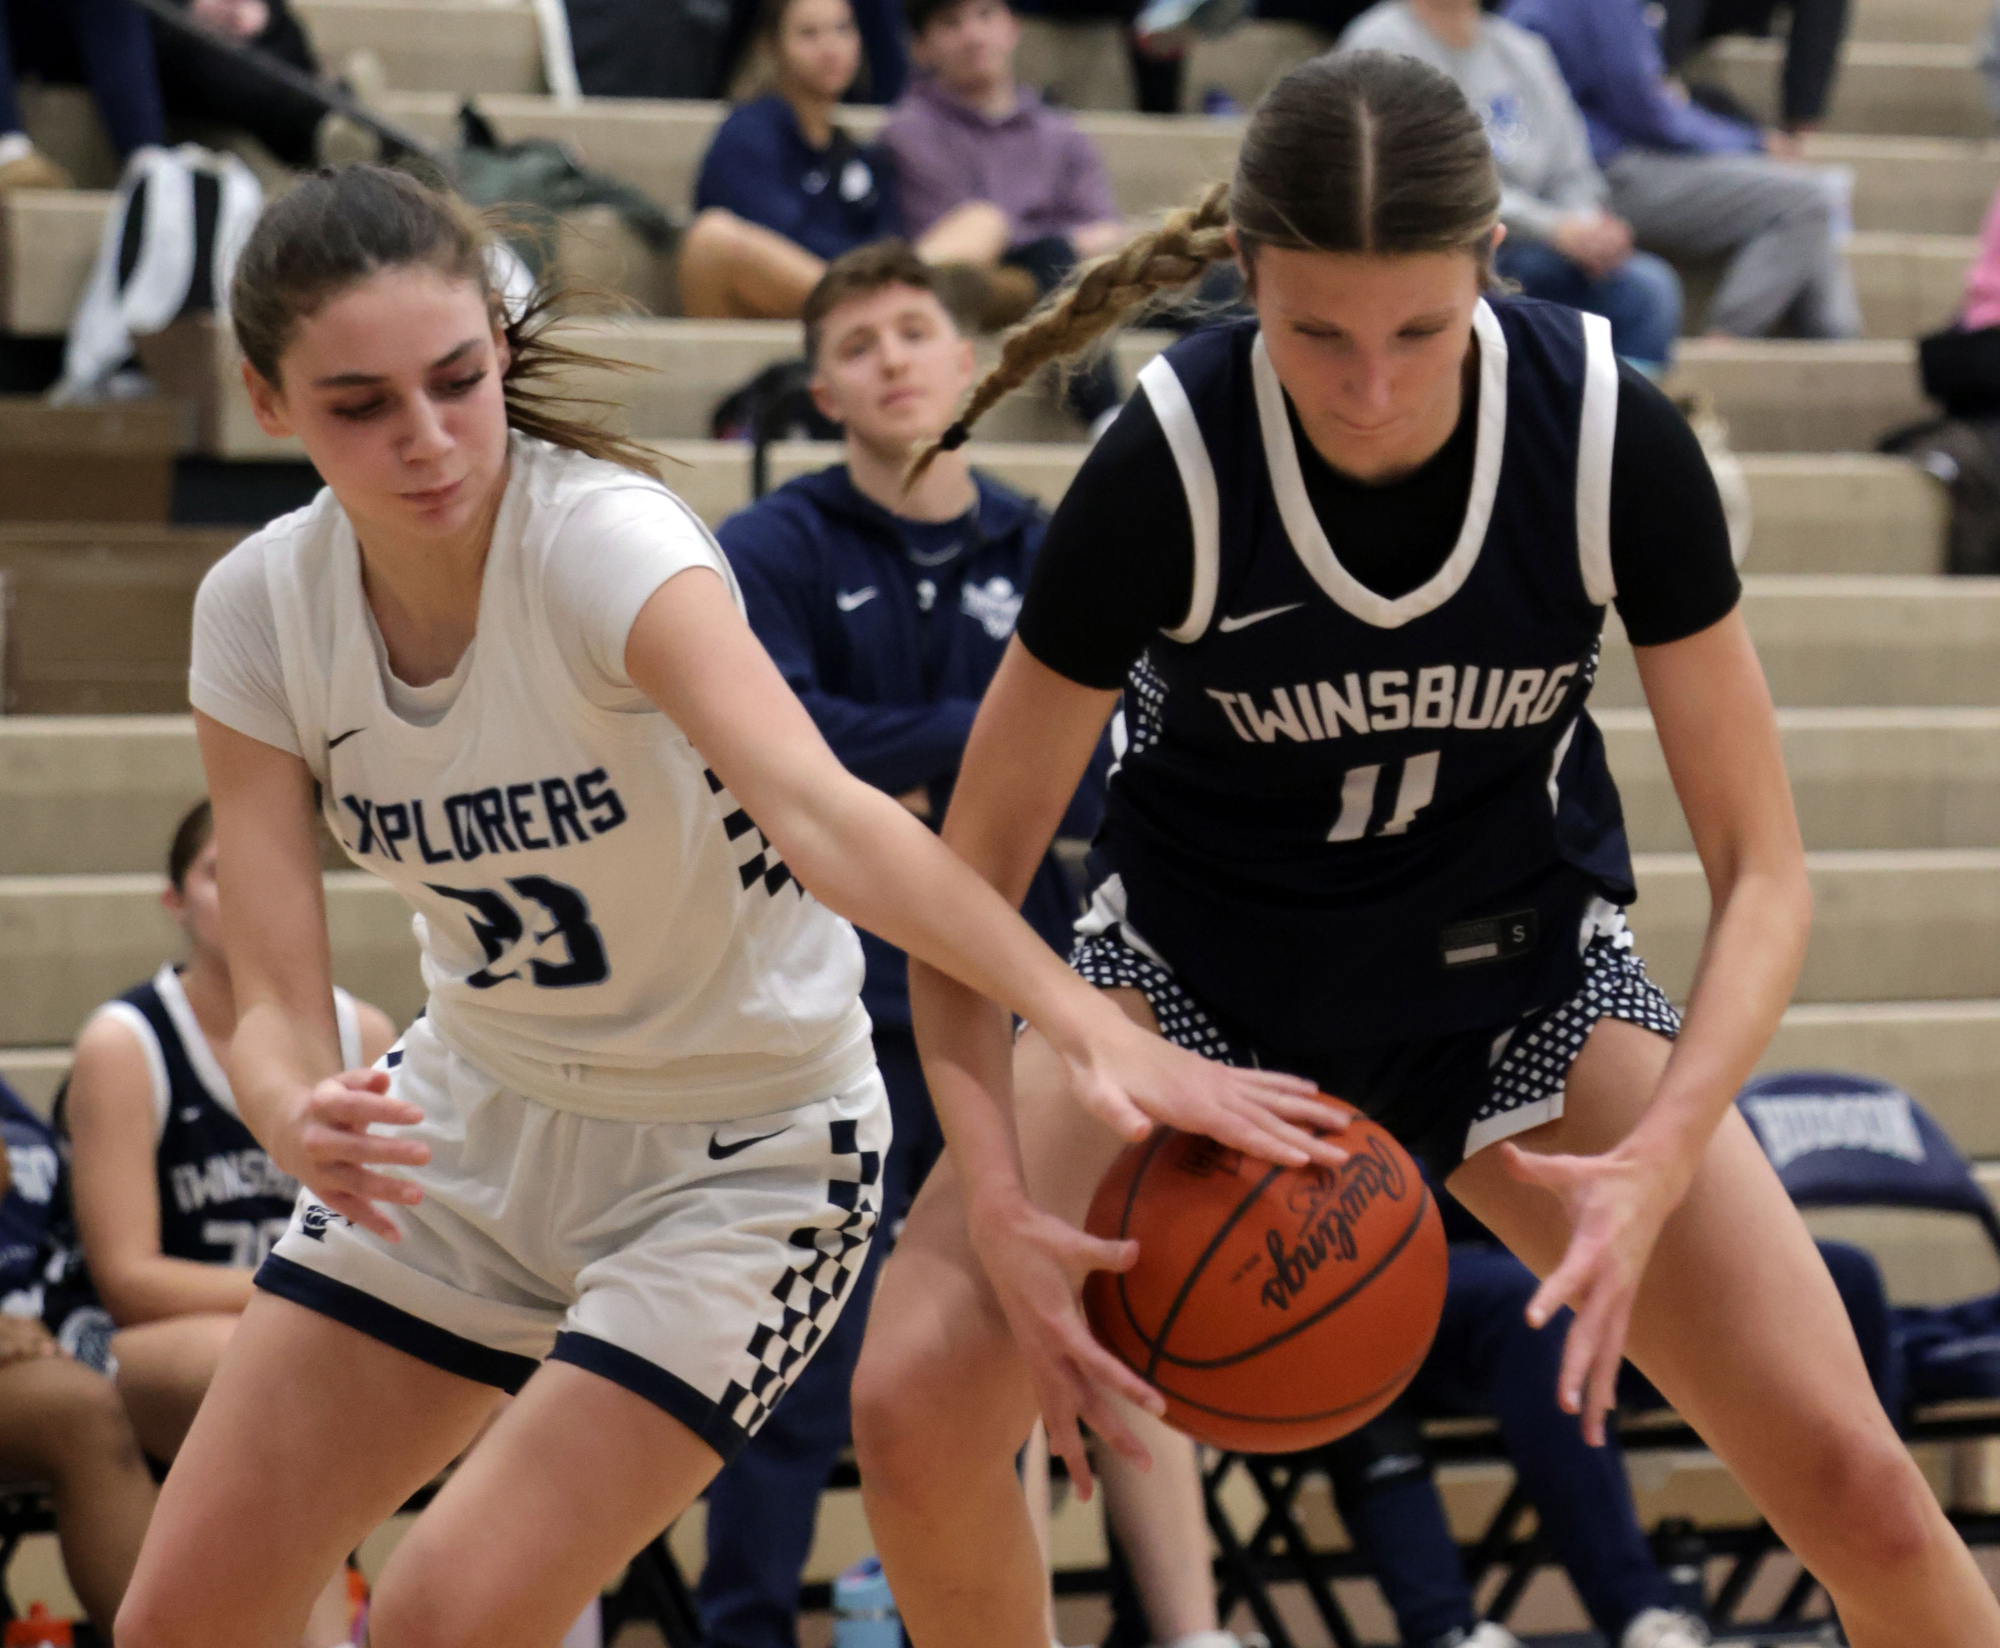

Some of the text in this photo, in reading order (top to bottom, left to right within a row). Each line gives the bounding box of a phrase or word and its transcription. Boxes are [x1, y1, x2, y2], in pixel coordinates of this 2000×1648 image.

[1206, 662, 1579, 743] TWINSBURG
[341, 766, 627, 864] XPLORERS
[1327, 751, 1440, 842] 11
[421, 874, 611, 989] 23
[1513, 925, 1526, 943] S
[1260, 1135, 1406, 1310] Rawlings
